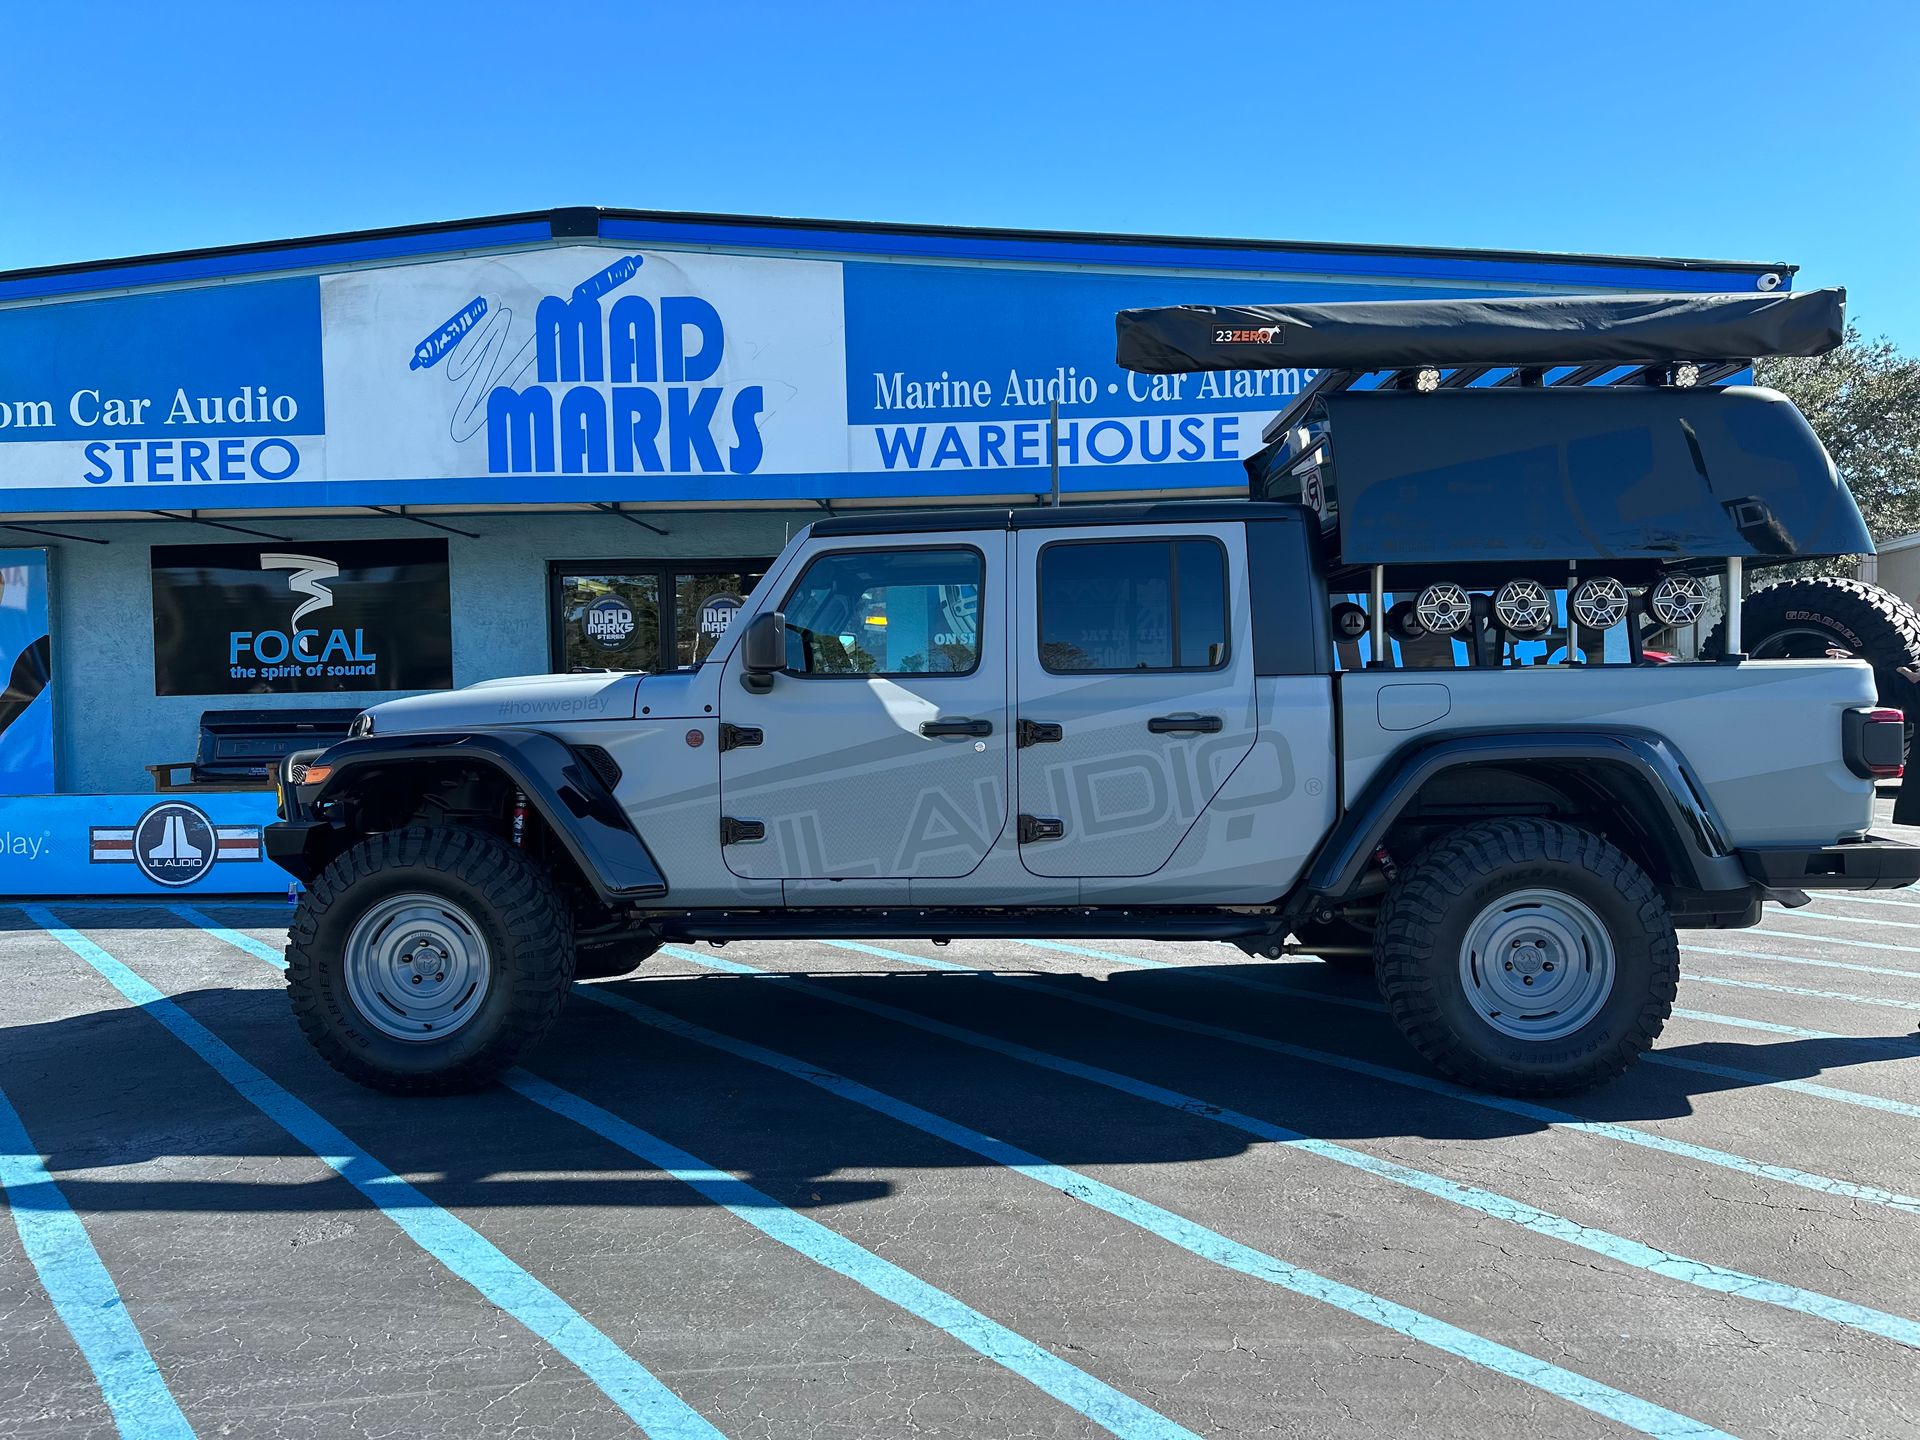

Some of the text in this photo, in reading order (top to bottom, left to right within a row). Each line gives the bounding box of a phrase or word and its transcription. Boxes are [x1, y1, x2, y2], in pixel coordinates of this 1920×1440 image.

[535, 295, 724, 383] MAD
[1215, 330, 1270, 342] 23ZERO
[873, 371, 992, 410] Marine
[1001, 366, 1098, 407] Audio
[1127, 369, 1187, 403] Car
[69, 389, 152, 427] Car
[163, 386, 298, 425] Audio
[487, 385, 764, 474] MARKS
[874, 416, 1239, 470] WAREHOUSE
[83, 438, 300, 484] STEREO
[587, 623, 635, 635] MARKS
[589, 609, 632, 624] MAD
[1785, 611, 1863, 648] GRABBER
[230, 628, 377, 664] FOCAL
[934, 633, 956, 645] ON
[230, 663, 376, 681] the spirit of sound
[498, 696, 609, 716] #howweplay
[889, 729, 1297, 874] AUDIO
[149, 859, 203, 867] JL AUDIO
